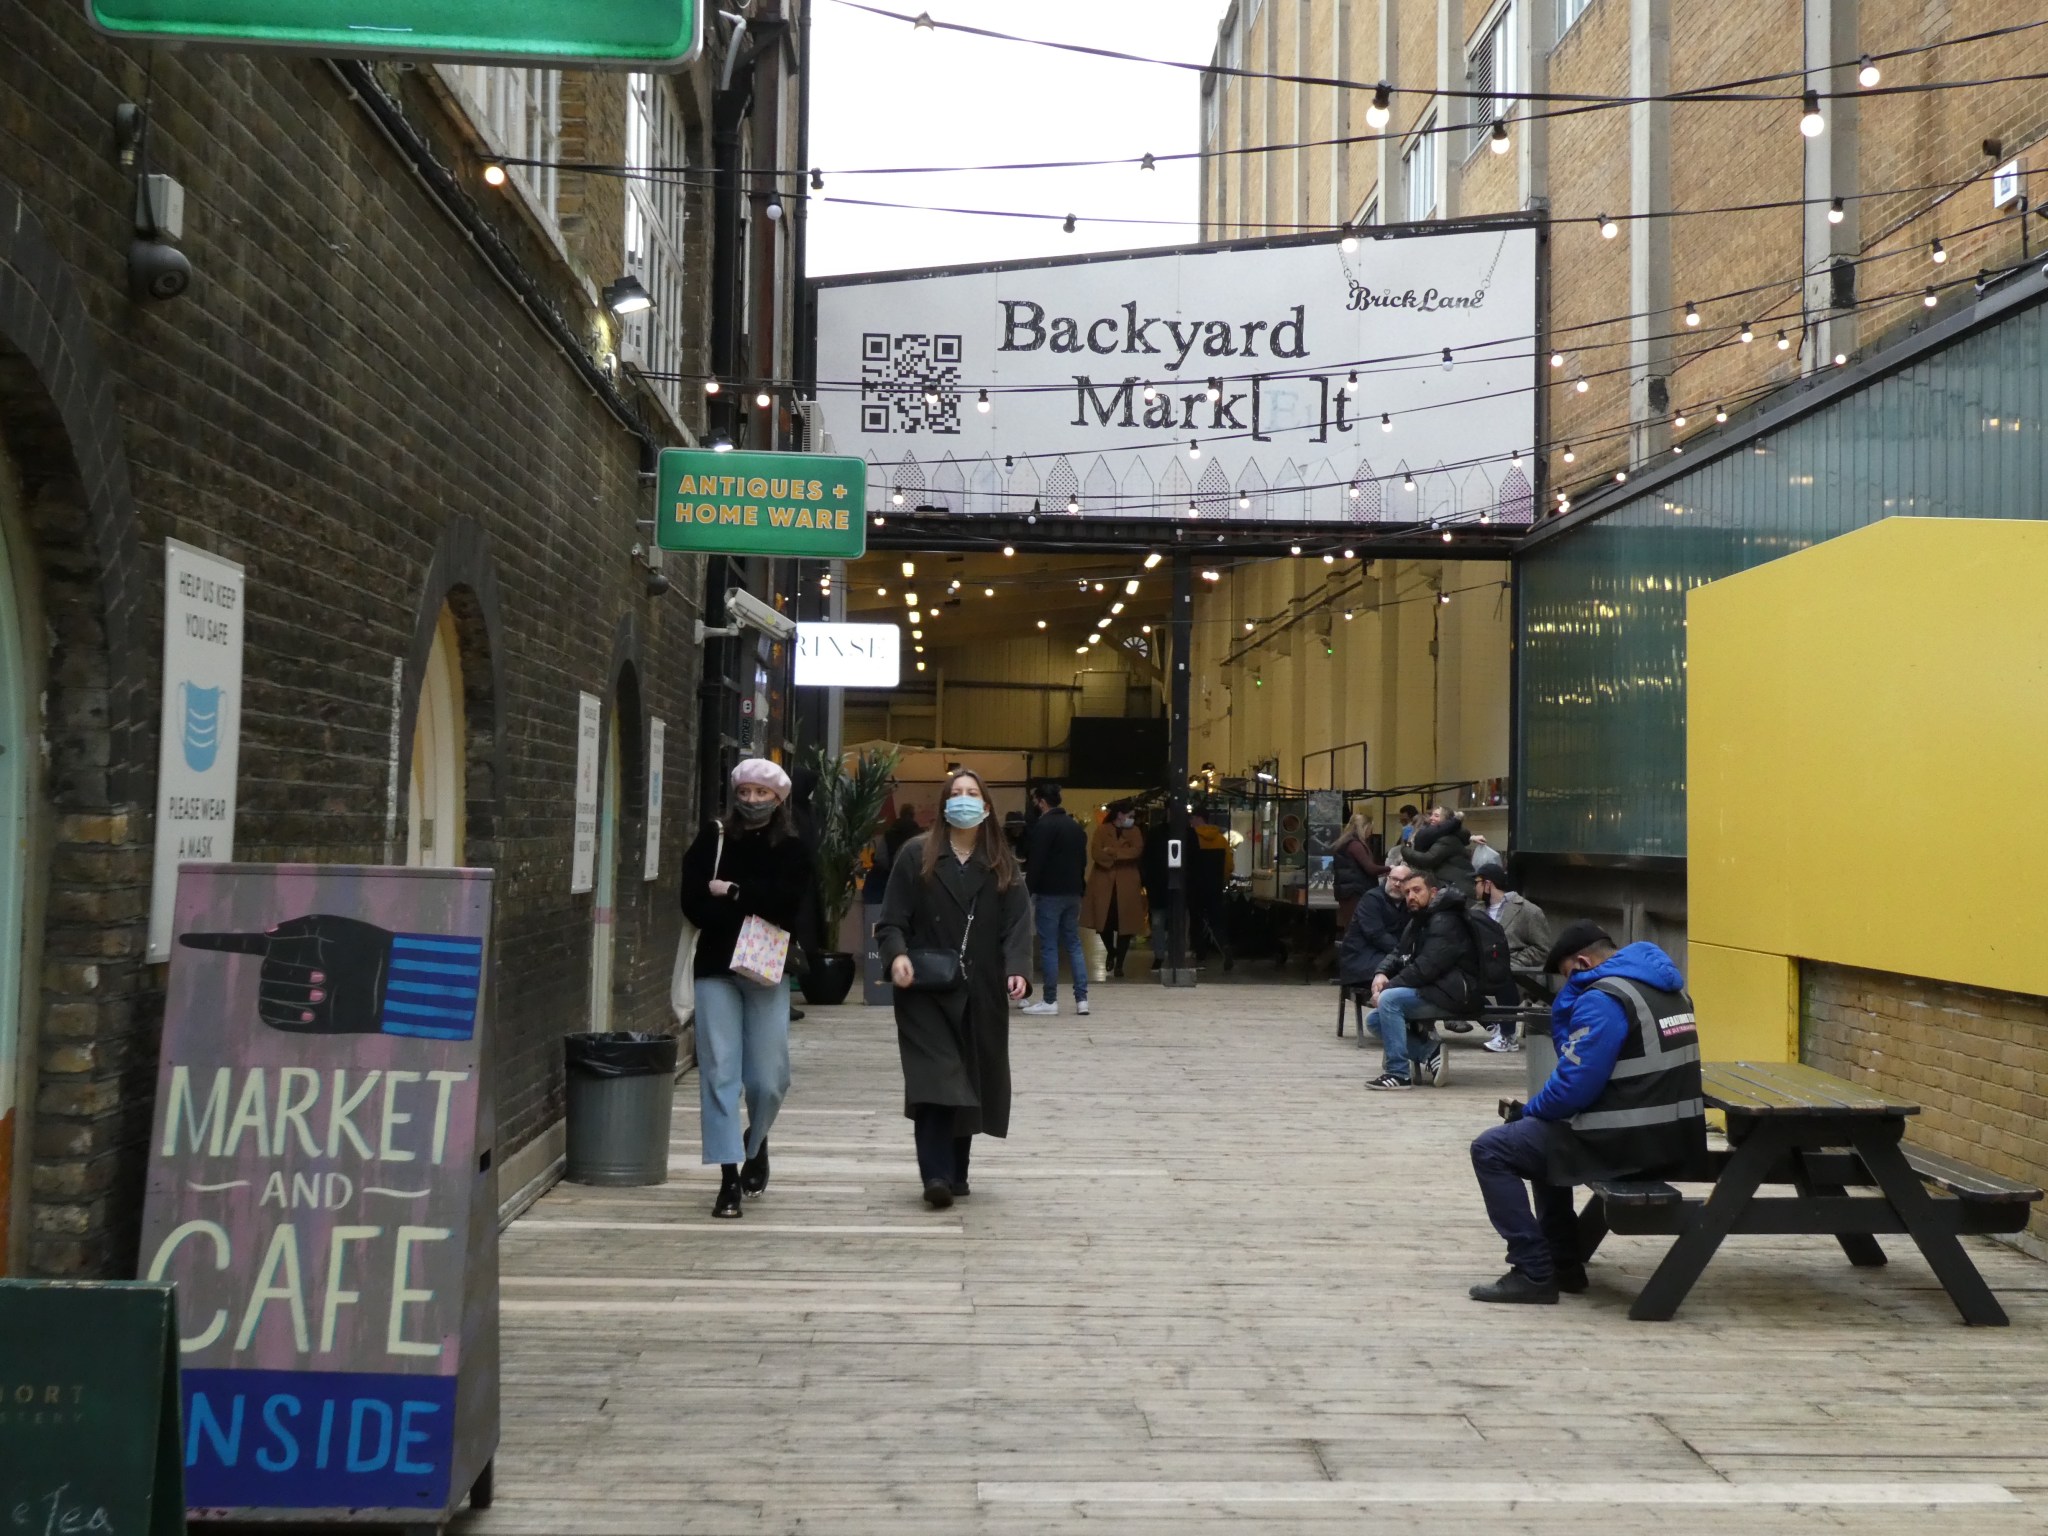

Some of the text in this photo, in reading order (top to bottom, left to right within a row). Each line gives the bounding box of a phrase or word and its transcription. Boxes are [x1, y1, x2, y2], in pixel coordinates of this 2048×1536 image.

[1346, 282, 1484, 312] Brick Lane
[998, 300, 1311, 371] Backyard
[678, 475, 823, 500] ANTIQUES
[675, 503, 850, 530] HOME WARE
[179, 570, 236, 610] HELP US KEEP
[186, 612, 228, 645] YOU SAFE
[169, 796, 226, 821] PLEASE WEAR
[178, 834, 213, 859] A MASK
[160, 1065, 470, 1165] MARKET
[259, 1170, 353, 1211] AND
[146, 1218, 455, 1357] CAFE
[186, 1391, 442, 1475] NSIDE
